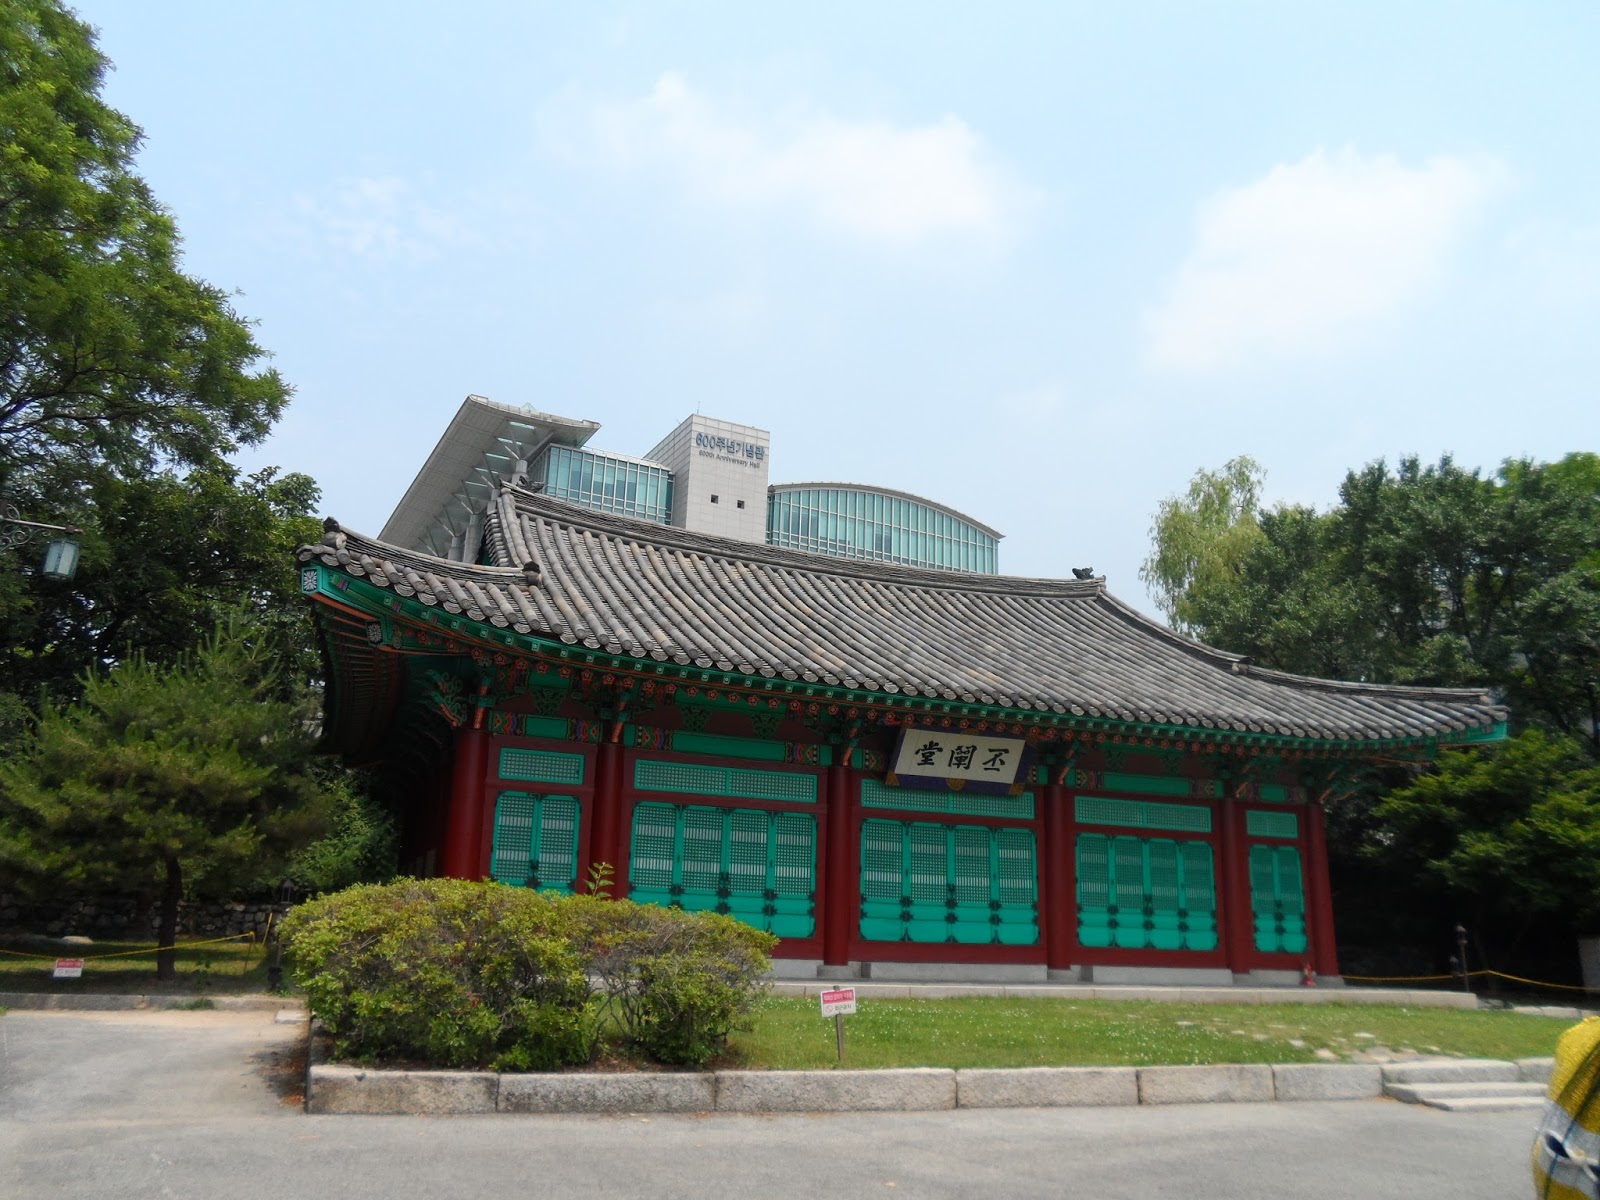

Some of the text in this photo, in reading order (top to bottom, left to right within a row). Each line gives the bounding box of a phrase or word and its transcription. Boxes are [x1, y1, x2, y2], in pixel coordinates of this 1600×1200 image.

[695, 432, 765, 460] 600주년기념관
[698, 450, 760, 469] 600th Anniversary Hall
